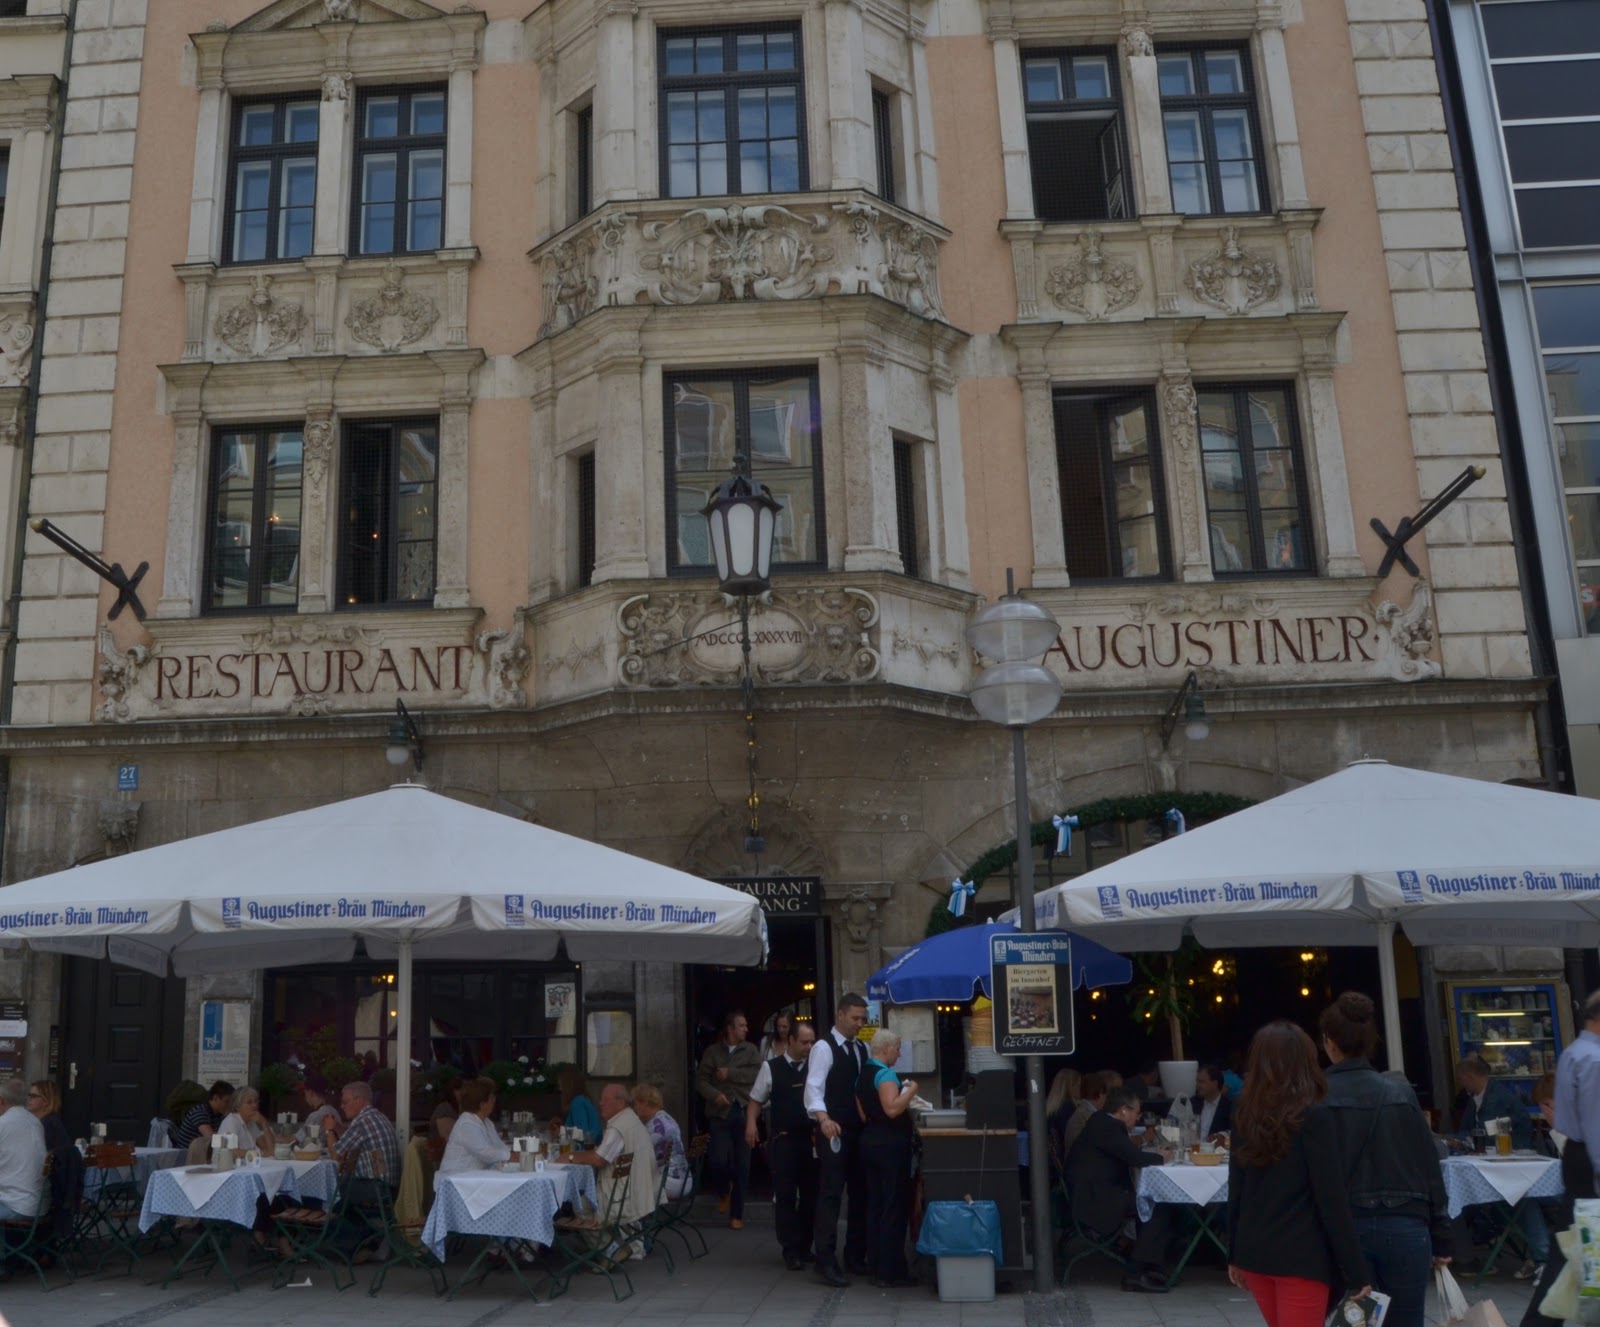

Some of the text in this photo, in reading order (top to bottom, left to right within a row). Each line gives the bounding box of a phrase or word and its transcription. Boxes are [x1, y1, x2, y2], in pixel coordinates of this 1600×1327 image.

[154, 645, 475, 700] RESTAURANT
[120, 767, 136, 779] 27
[725, 882, 814, 895] TAURANT
[1258, 881, 1318, 901] München
[97, 906, 148, 925] München
[371, 900, 426, 918] München
[659, 904, 717, 923] München
[1021, 950, 1056, 962] München
[1002, 1034, 1064, 1048] GEÖFFNET
